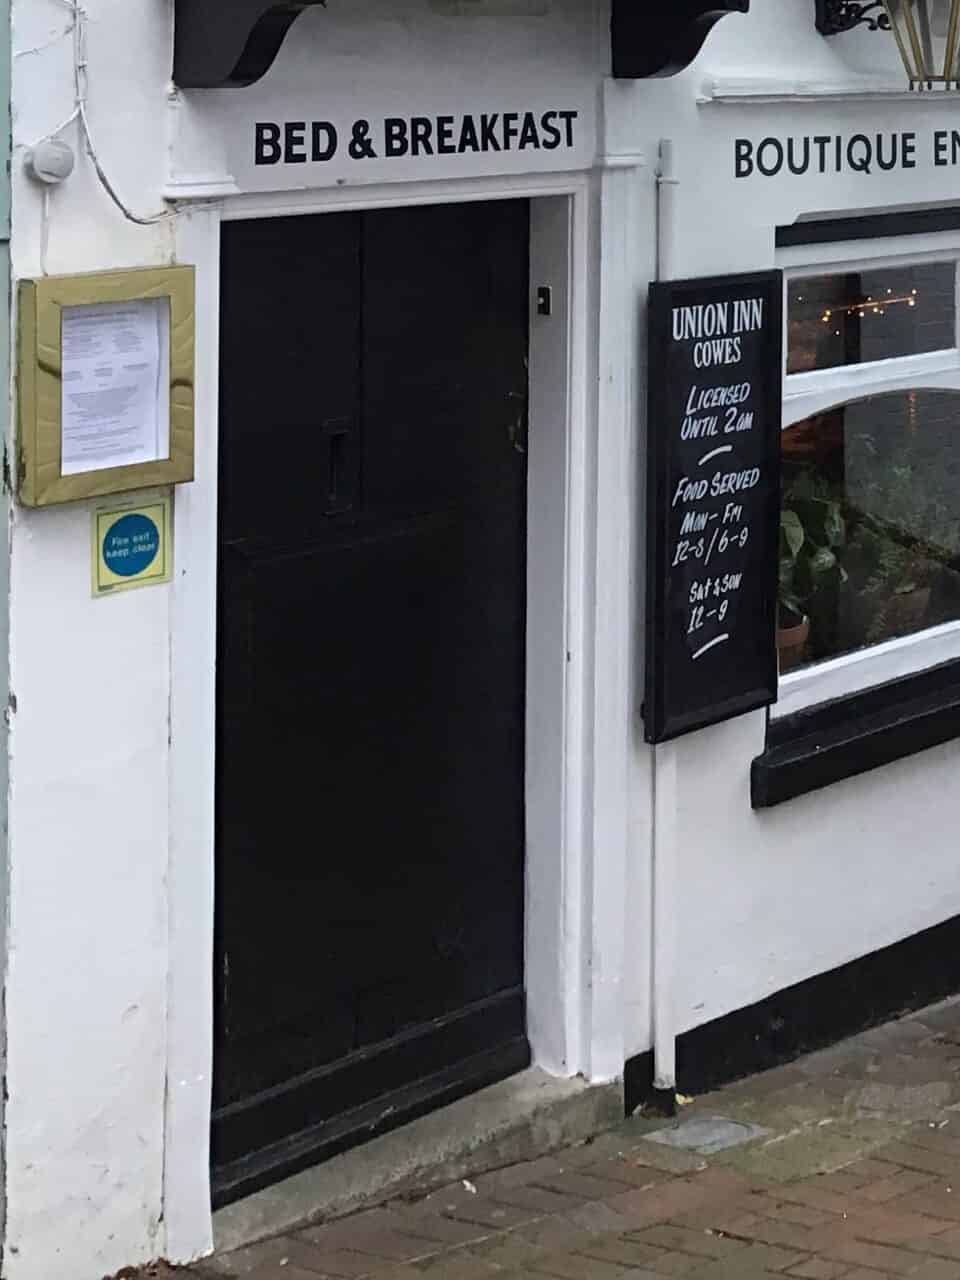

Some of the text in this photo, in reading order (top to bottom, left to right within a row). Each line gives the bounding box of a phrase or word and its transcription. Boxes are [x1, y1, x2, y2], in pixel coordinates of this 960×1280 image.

[255, 110, 578, 165] BED & BREAKFAST
[735, 132, 916, 178] BOUTIQUE
[672, 298, 763, 340] UNION INN
[693, 337, 741, 368] COWES
